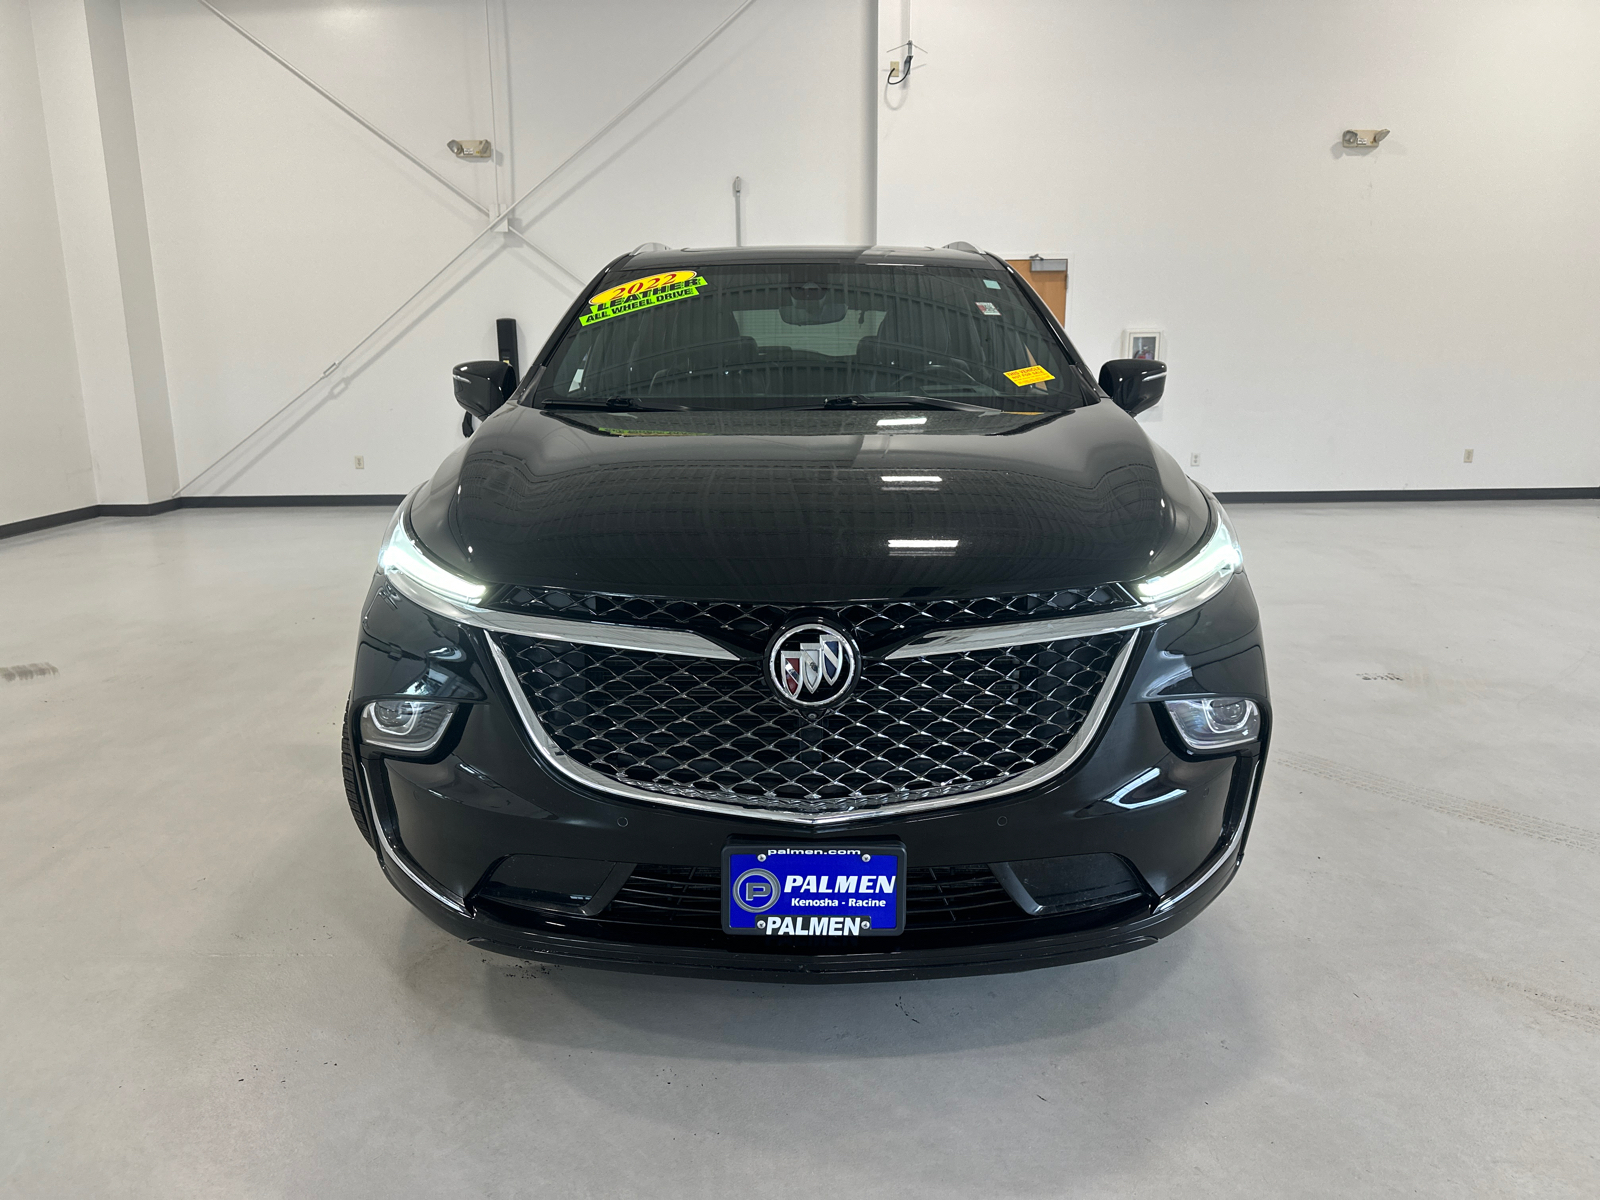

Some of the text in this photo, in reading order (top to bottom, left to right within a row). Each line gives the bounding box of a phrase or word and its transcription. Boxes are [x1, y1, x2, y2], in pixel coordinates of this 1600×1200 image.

[597, 278, 700, 311] LEATHER
[610, 273, 677, 300] 2022
[585, 287, 694, 323] ALL WHEEL DRIVE
[784, 875, 896, 893] PALMEN
[791, 898, 839, 907] Kenosha
[848, 898, 886, 907] Racine
[766, 917, 861, 935] PALMEN
